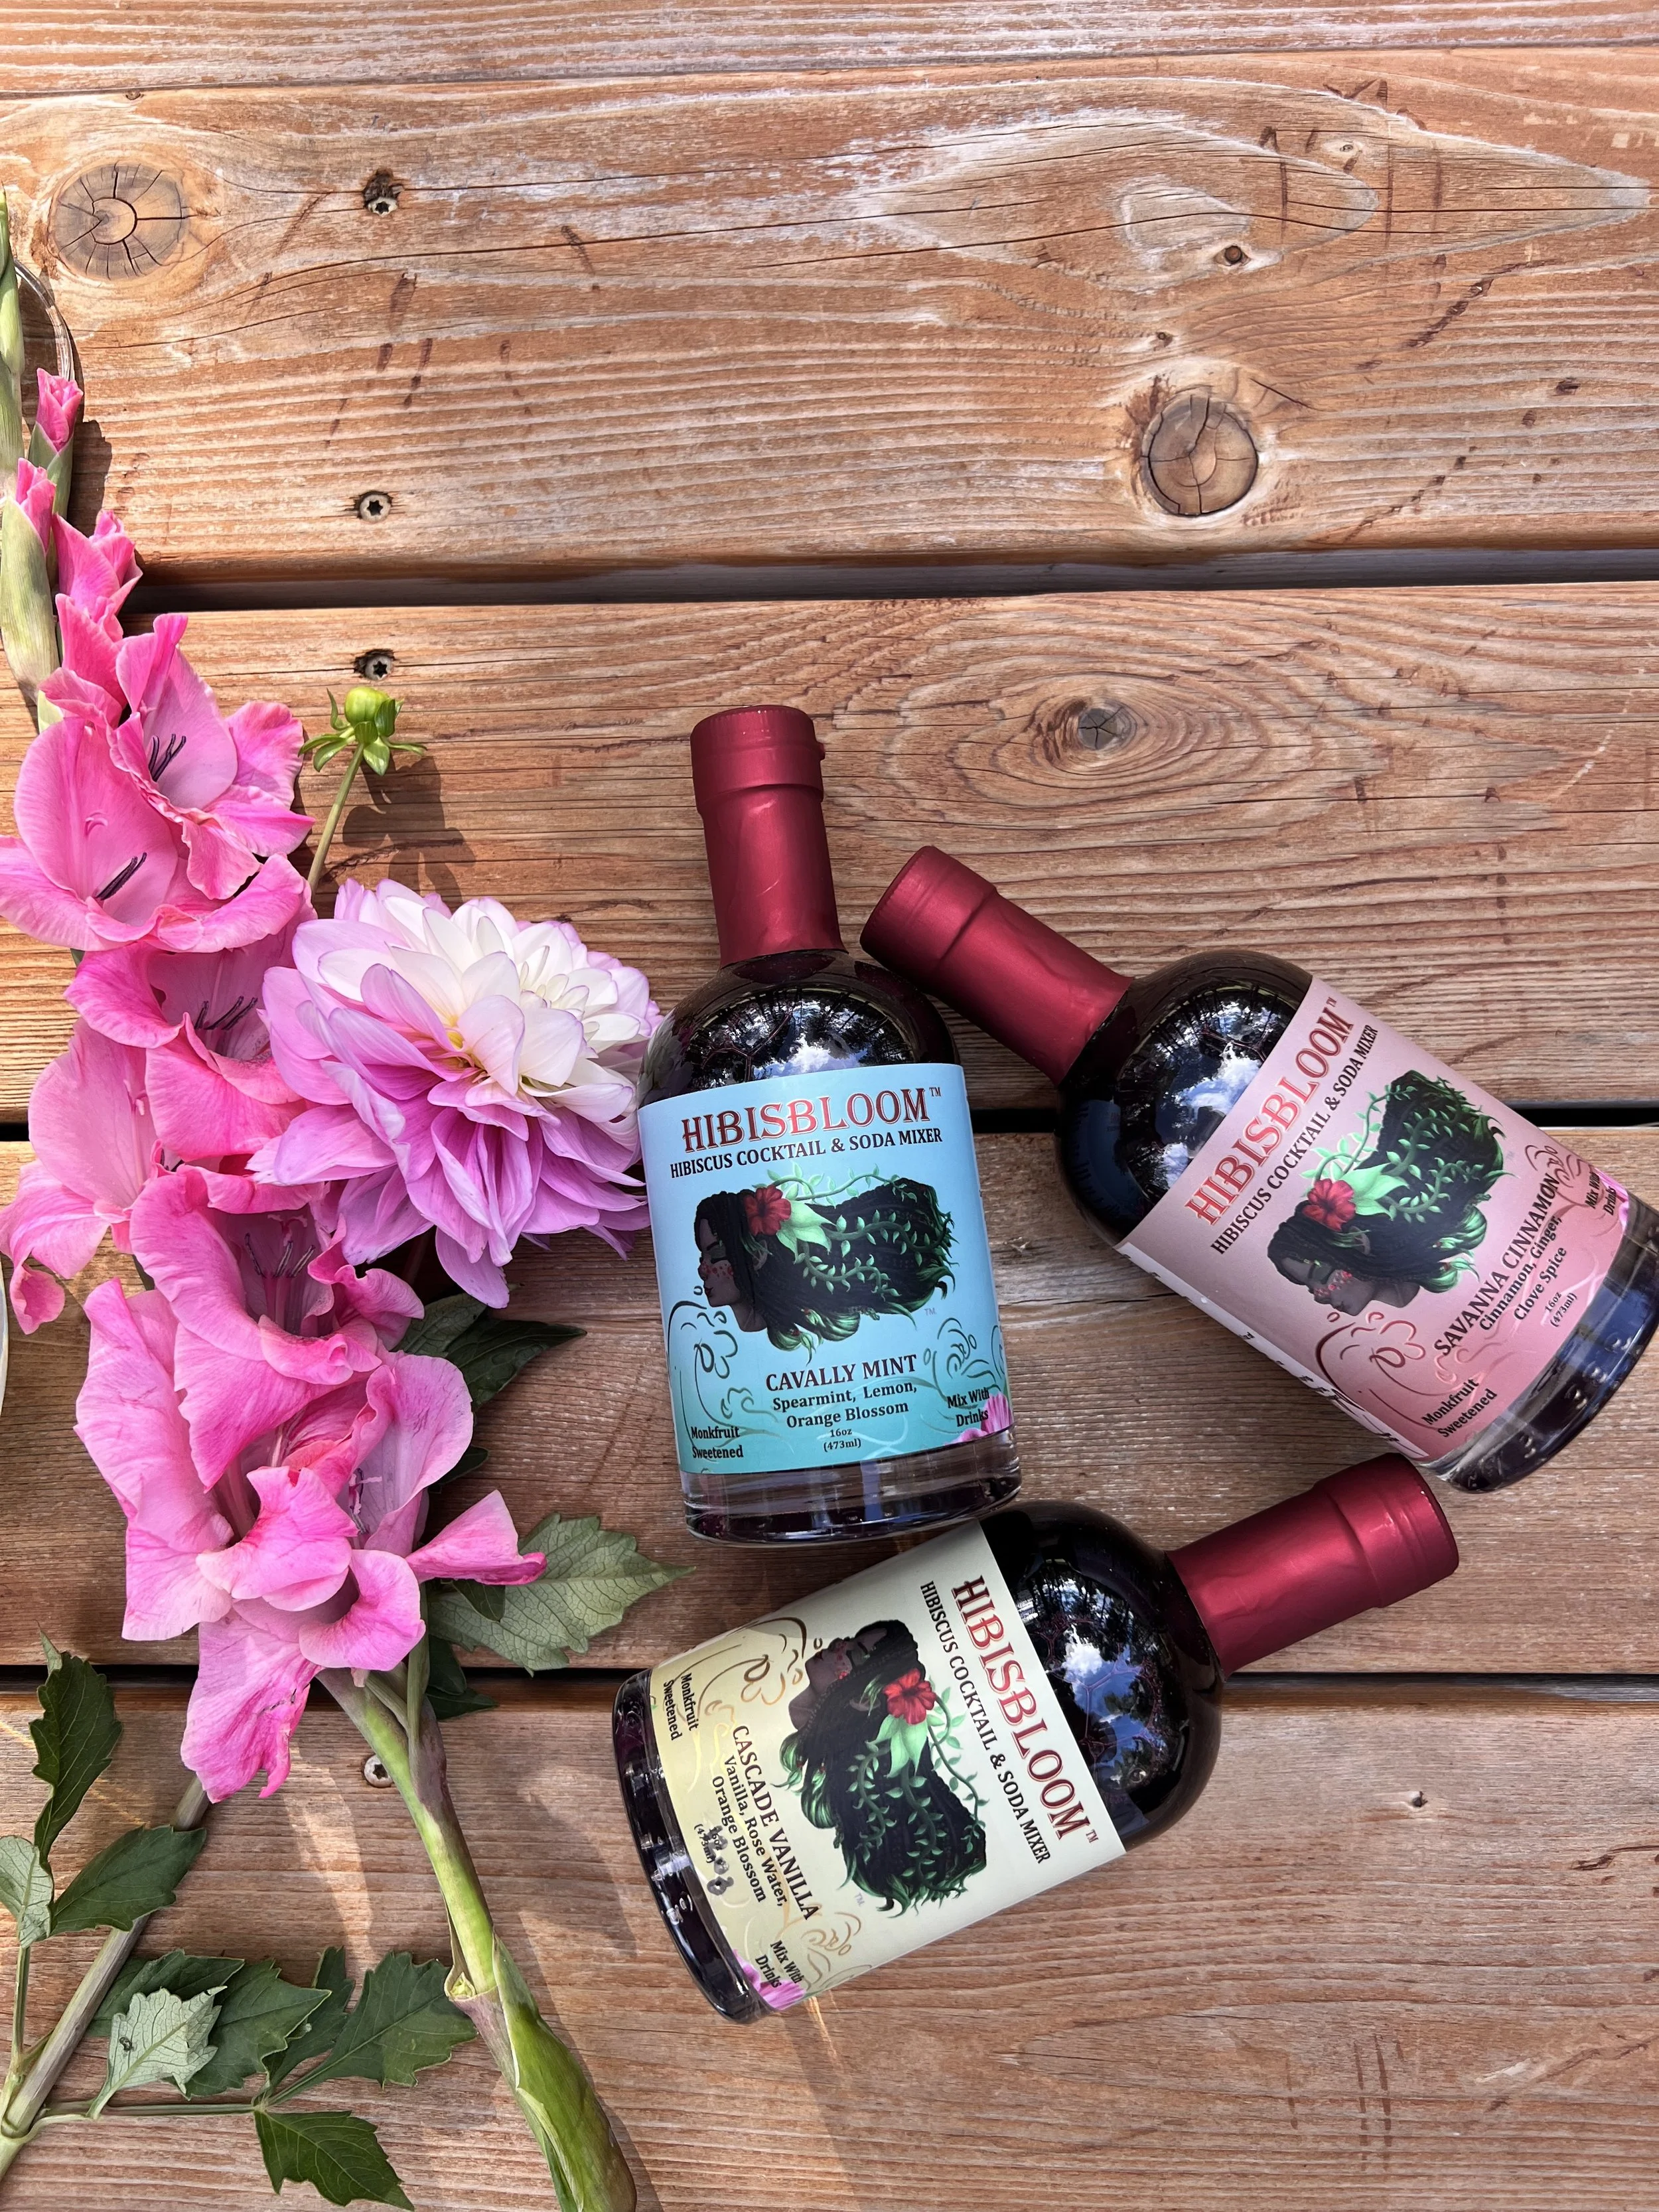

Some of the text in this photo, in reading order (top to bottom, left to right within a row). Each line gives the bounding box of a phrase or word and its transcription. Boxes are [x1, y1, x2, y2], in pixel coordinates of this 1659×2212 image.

[681, 1088, 930, 1153] HIBISBLOOM
[1184, 1005, 1354, 1226] HIBISBLOOM
[1210, 1024, 1378, 1254] HIBISCUS COCKTAIL & SODA MIXER
[670, 1128, 943, 1178] HIBISCUS COCKTAIL & SODA MIXER
[1433, 1173, 1561, 1356] SAVANNA CINNAMON
[1479, 1215, 1563, 1331] Cinnamon, Ginger,
[1514, 1246, 1567, 1321] Clove Spice
[1544, 1291, 1561, 1313] 16oz
[1550, 1292, 1578, 1328] (473ml)
[766, 1354, 917, 1391] CAVALLY MINT
[772, 1382, 917, 1412] Spearmint, Lemon,
[947, 1387, 990, 1408] Mix With
[786, 1402, 909, 1428] Orange Blossom
[956, 1408, 989, 1427] Drinks
[1421, 1378, 1479, 1425] Monkfruit
[1437, 1388, 1497, 1438] Sweetened
[691, 1426, 741, 1439] Monkfruit
[692, 1444, 744, 1459] Sweetened
[824, 1438, 861, 1452] (473ml)
[830, 1428, 852, 1438] 16oz
[664, 1680, 682, 1740] Sweetened
[681, 1672, 699, 1731] Monkfruit
[920, 1580, 1052, 1864] HIBISCUS COCKTAIL & SODA MIXER
[952, 1574, 1090, 1840] HIBISBLOOM
[712, 1775, 766, 1903] Orange Blossom
[724, 1755, 788, 1907] Vanilla, Rose Water,
[733, 1726, 820, 1920] CASCADE VANILLA
[755, 1954, 782, 1988] Drinks
[770, 1940, 804, 1984] Mix With
